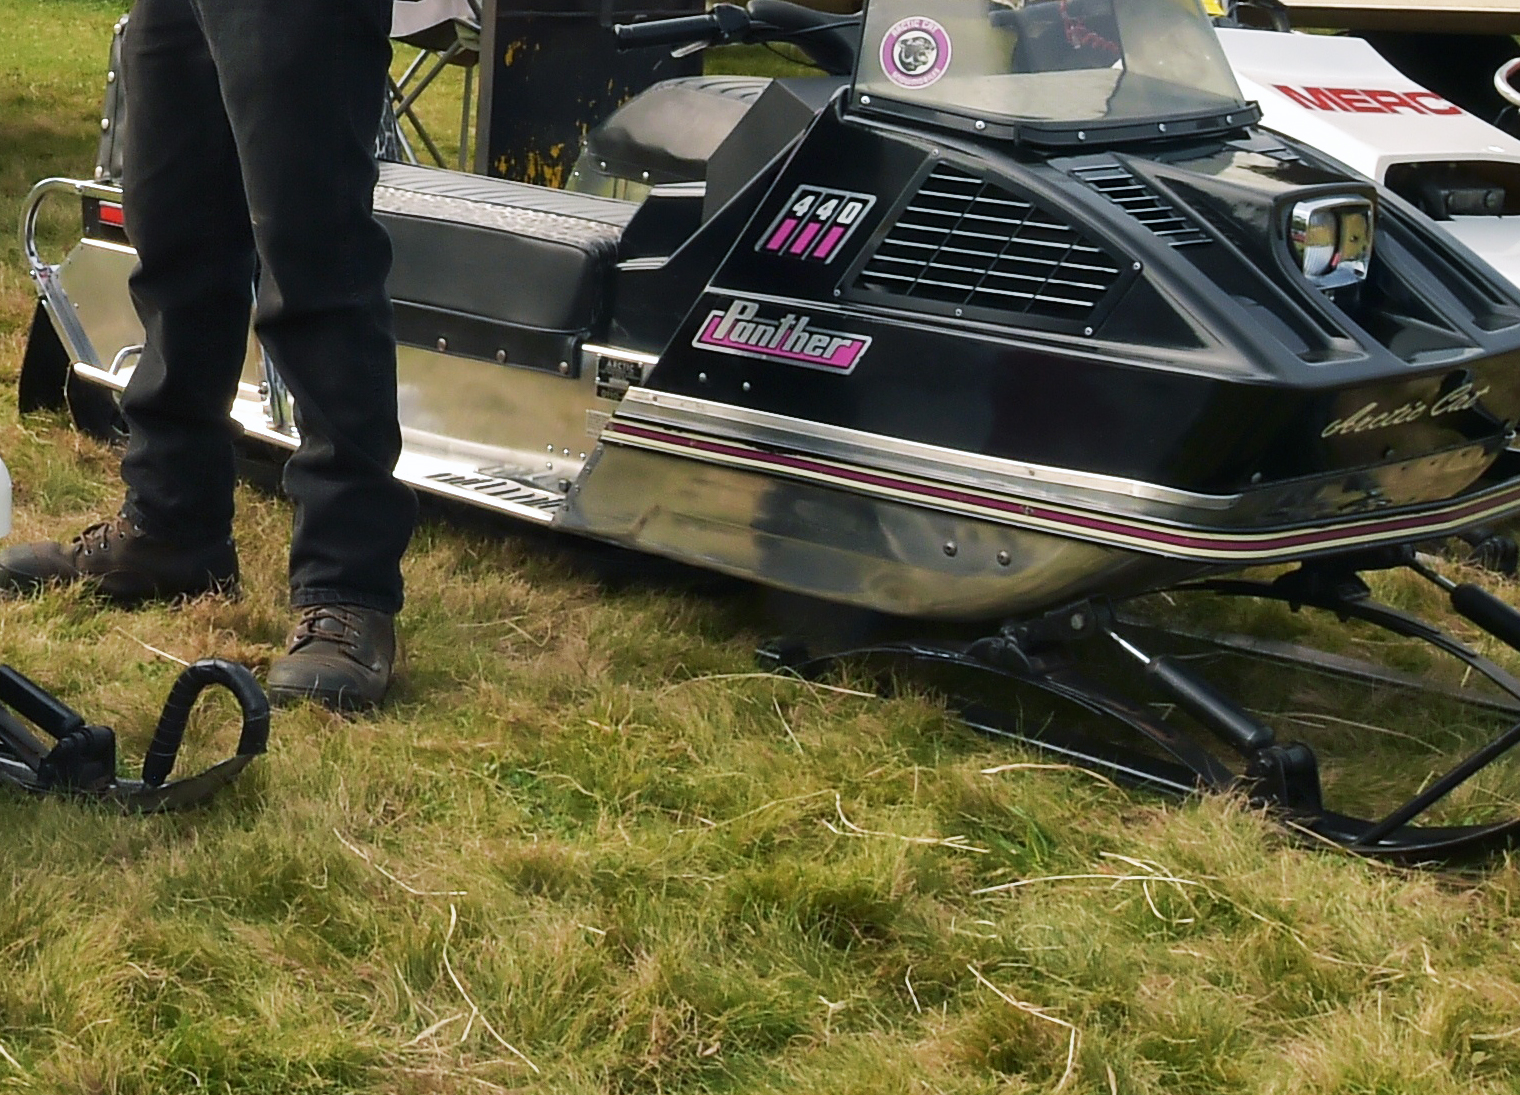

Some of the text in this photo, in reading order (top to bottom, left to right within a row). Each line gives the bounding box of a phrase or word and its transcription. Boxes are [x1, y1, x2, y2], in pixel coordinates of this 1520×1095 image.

[1271, 84, 1464, 115] MERC
[792, 195, 863, 225] 440
[711, 299, 854, 360] Panther
[1321, 383, 1491, 439] Arctic Cat
